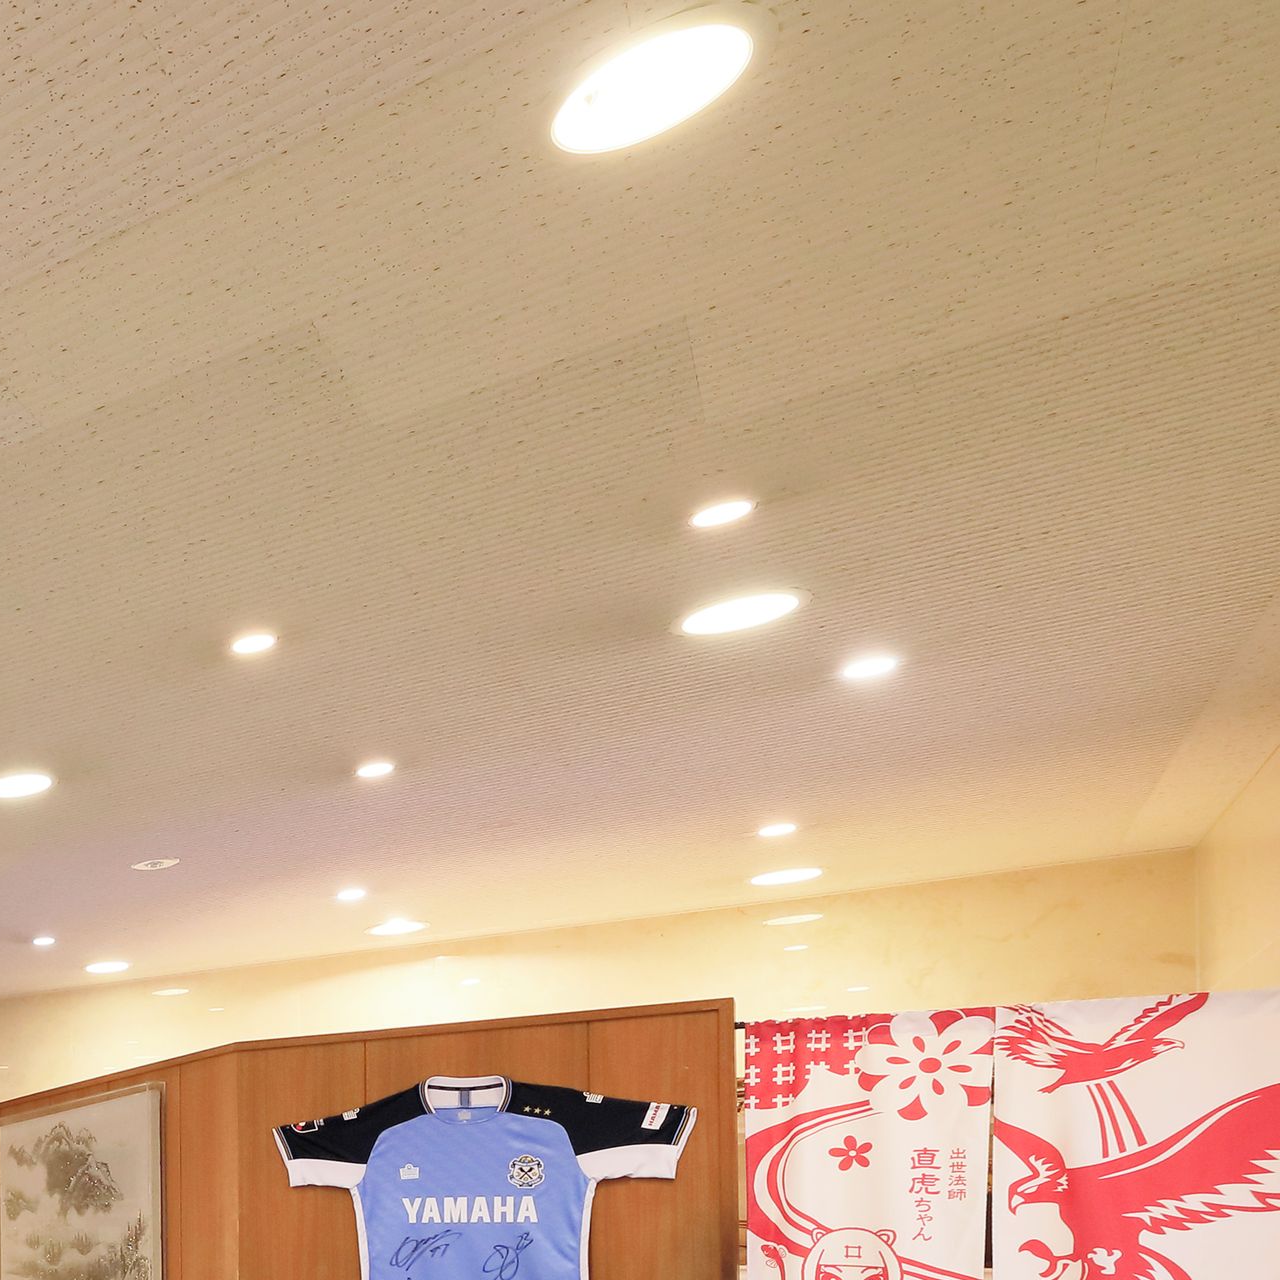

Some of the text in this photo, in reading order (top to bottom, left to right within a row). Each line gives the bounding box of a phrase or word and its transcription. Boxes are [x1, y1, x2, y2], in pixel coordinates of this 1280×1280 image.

[909, 1147, 942, 1242] 直虎ちゃん
[947, 1147, 968, 1201] 出世法師
[401, 1195, 539, 1224] YAMAHA
